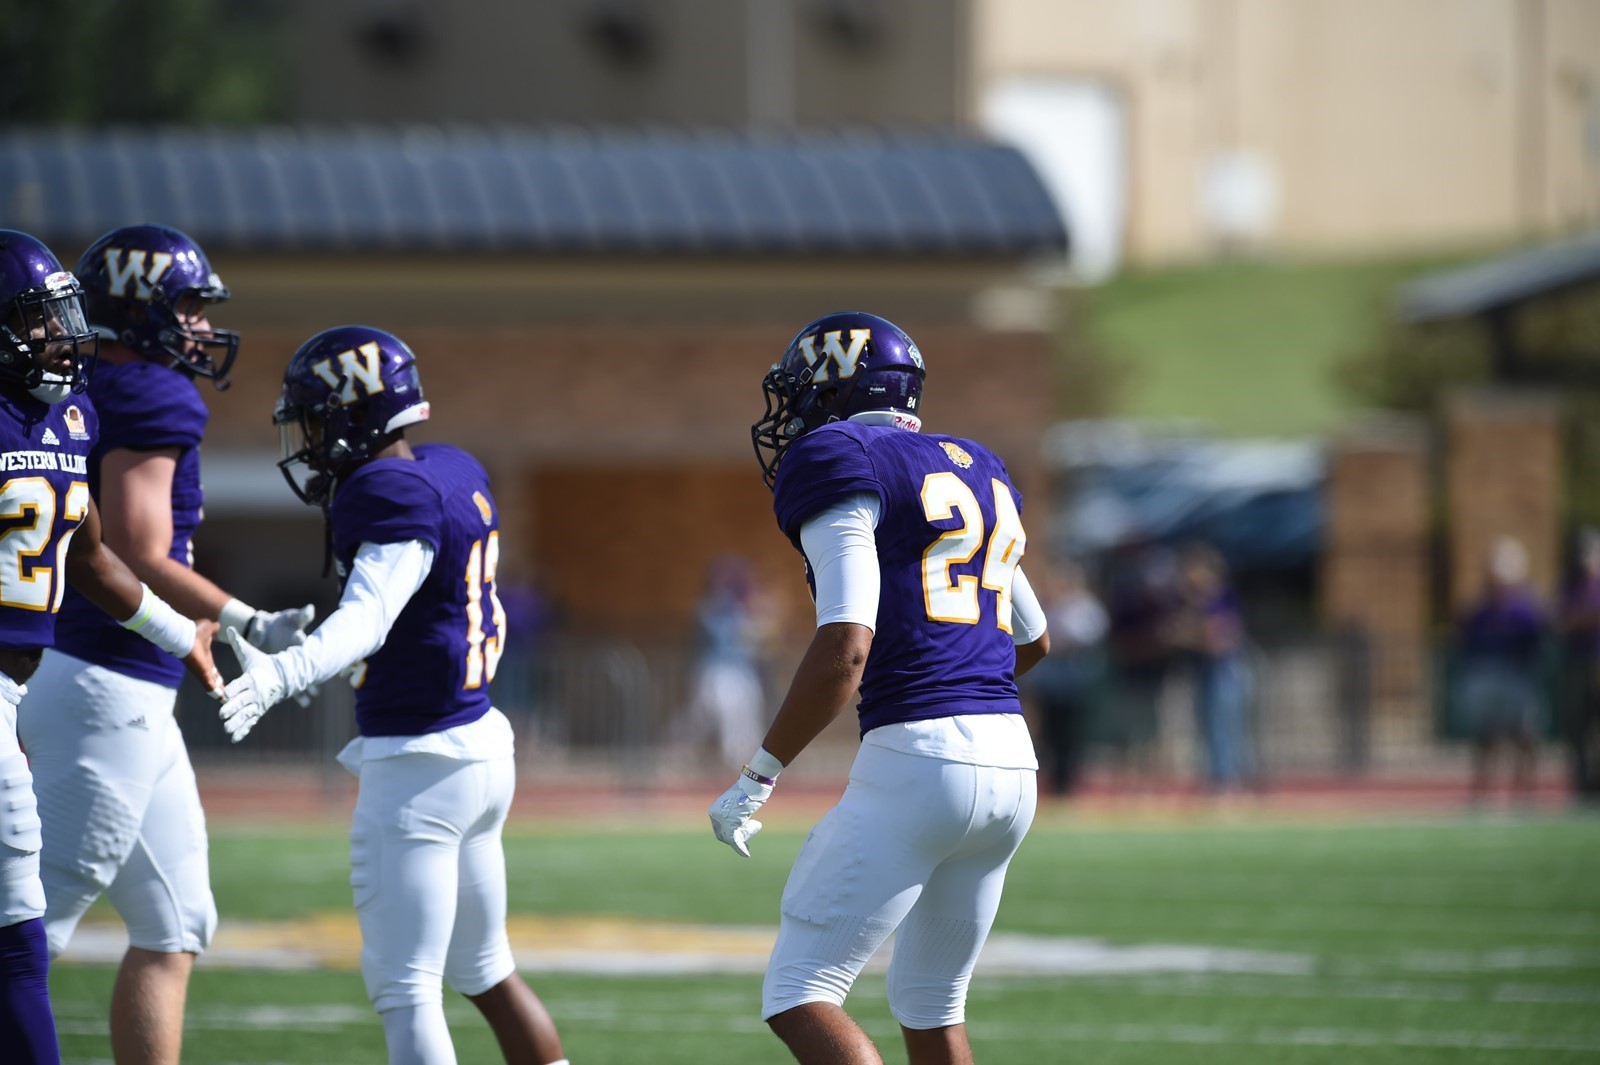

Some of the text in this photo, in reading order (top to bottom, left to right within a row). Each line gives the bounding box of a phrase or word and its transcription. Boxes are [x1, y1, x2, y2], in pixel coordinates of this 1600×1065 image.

[105, 248, 172, 298] W
[312, 341, 385, 405] W
[799, 328, 870, 383] W
[907, 396, 916, 409] 24
[920, 472, 1026, 635] 24
